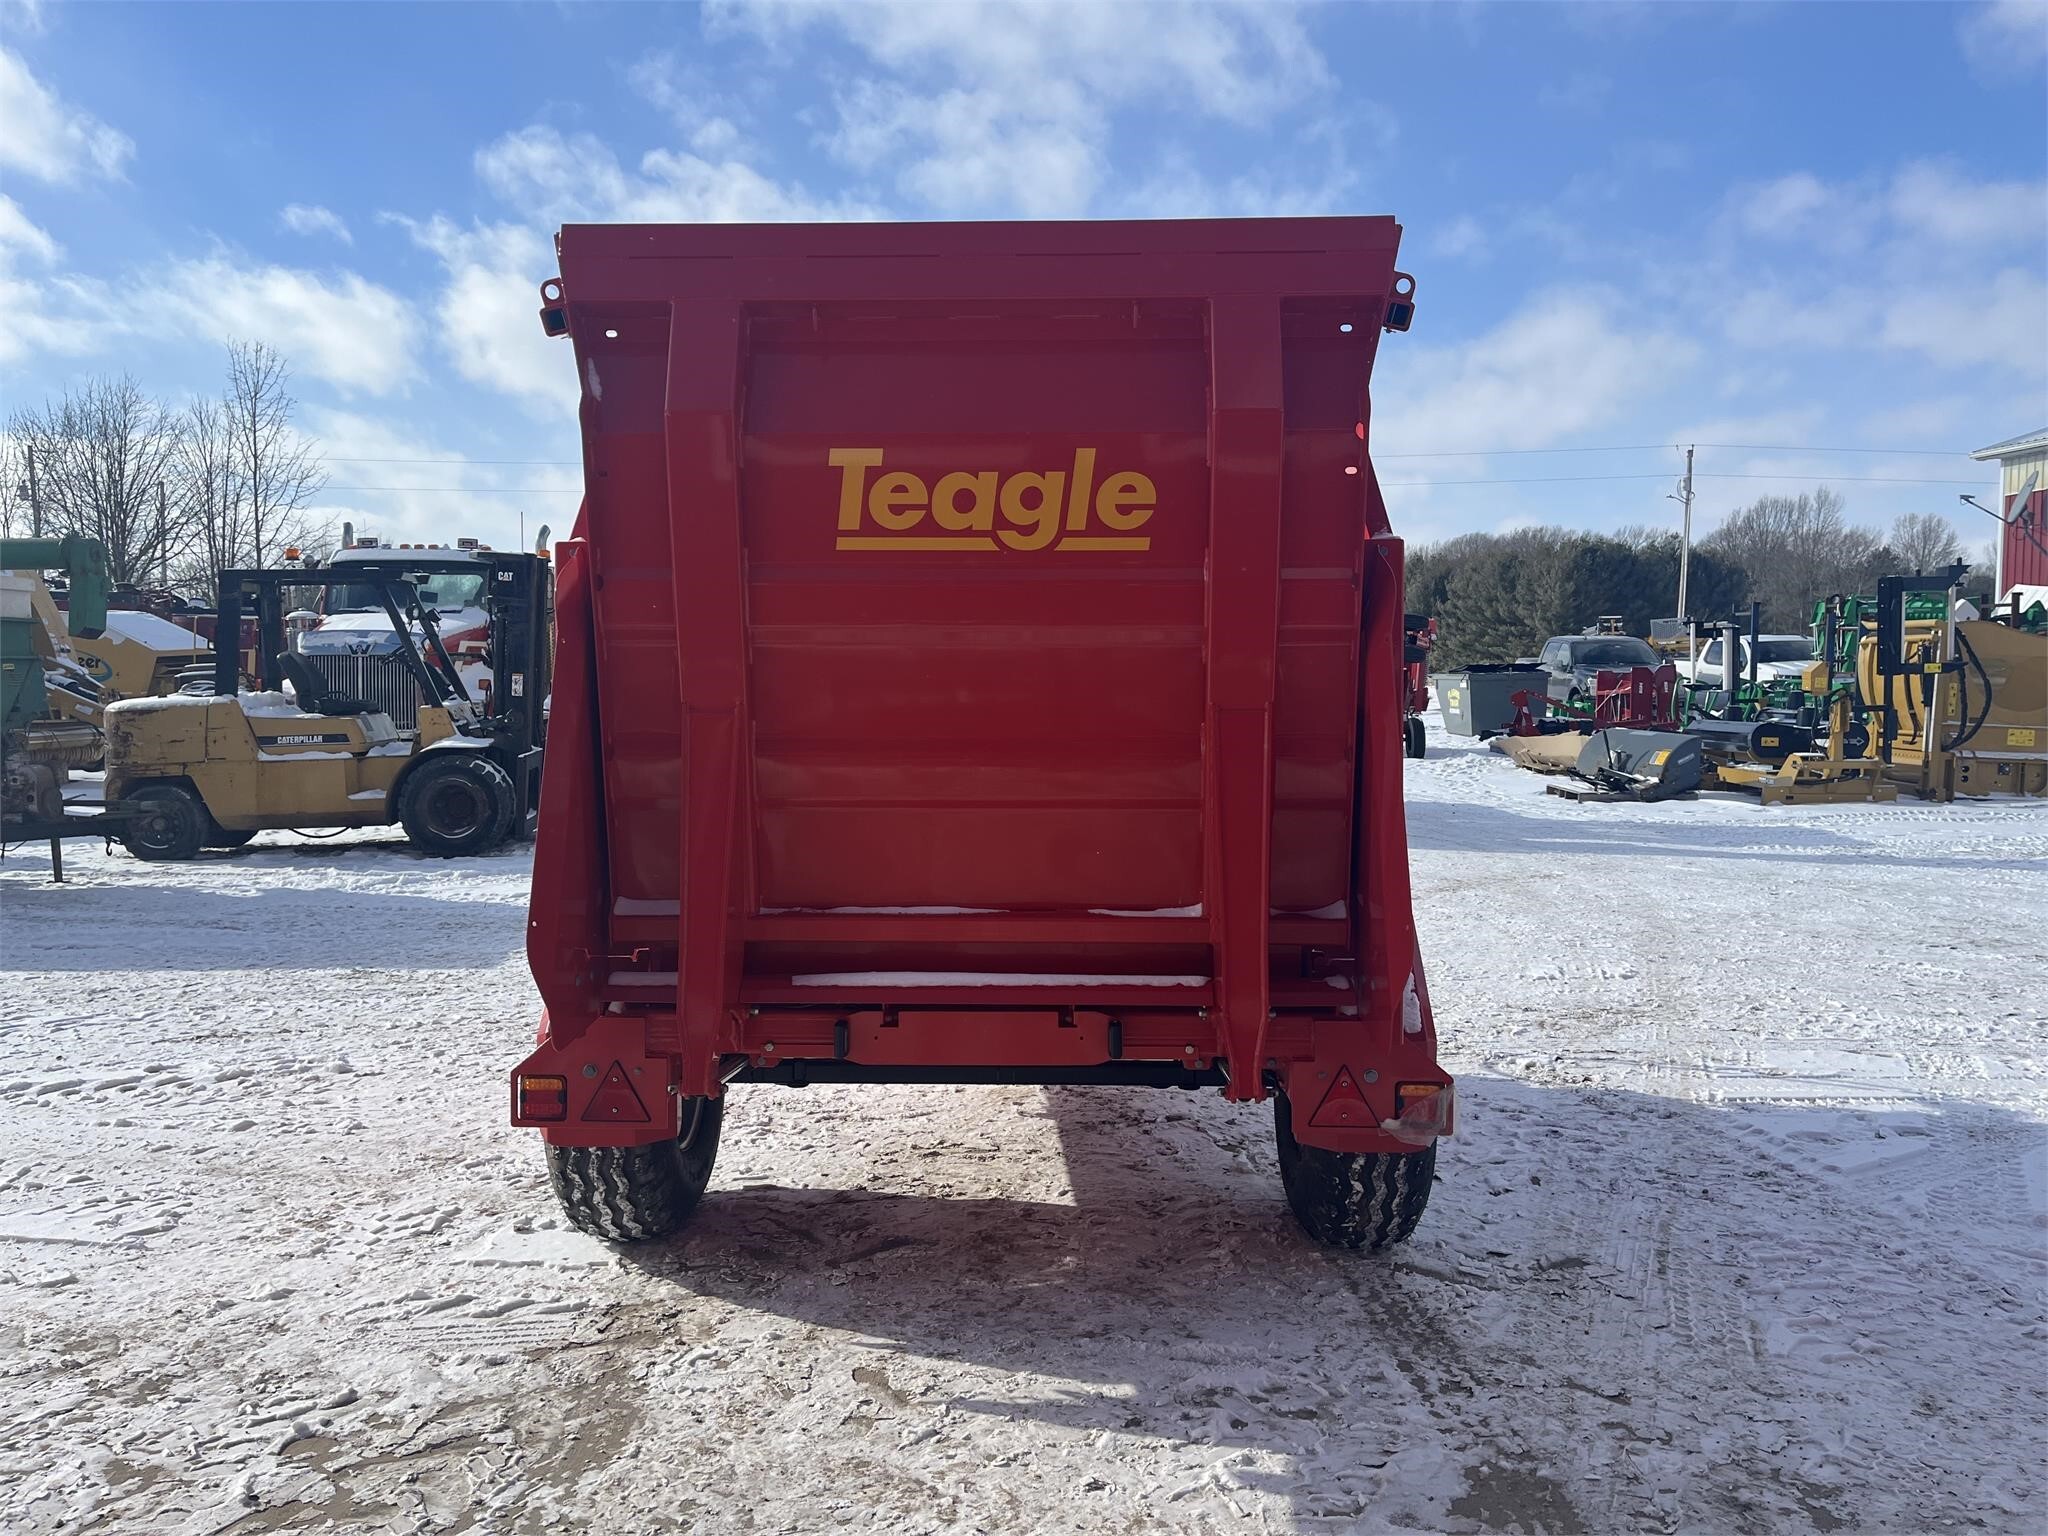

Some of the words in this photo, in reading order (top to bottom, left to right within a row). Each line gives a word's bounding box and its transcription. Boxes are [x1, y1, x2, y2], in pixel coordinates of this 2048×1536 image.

[828, 447, 1157, 551] Teagle
[497, 571, 514, 582] CAT
[277, 735, 323, 744] CATERPILLAR
